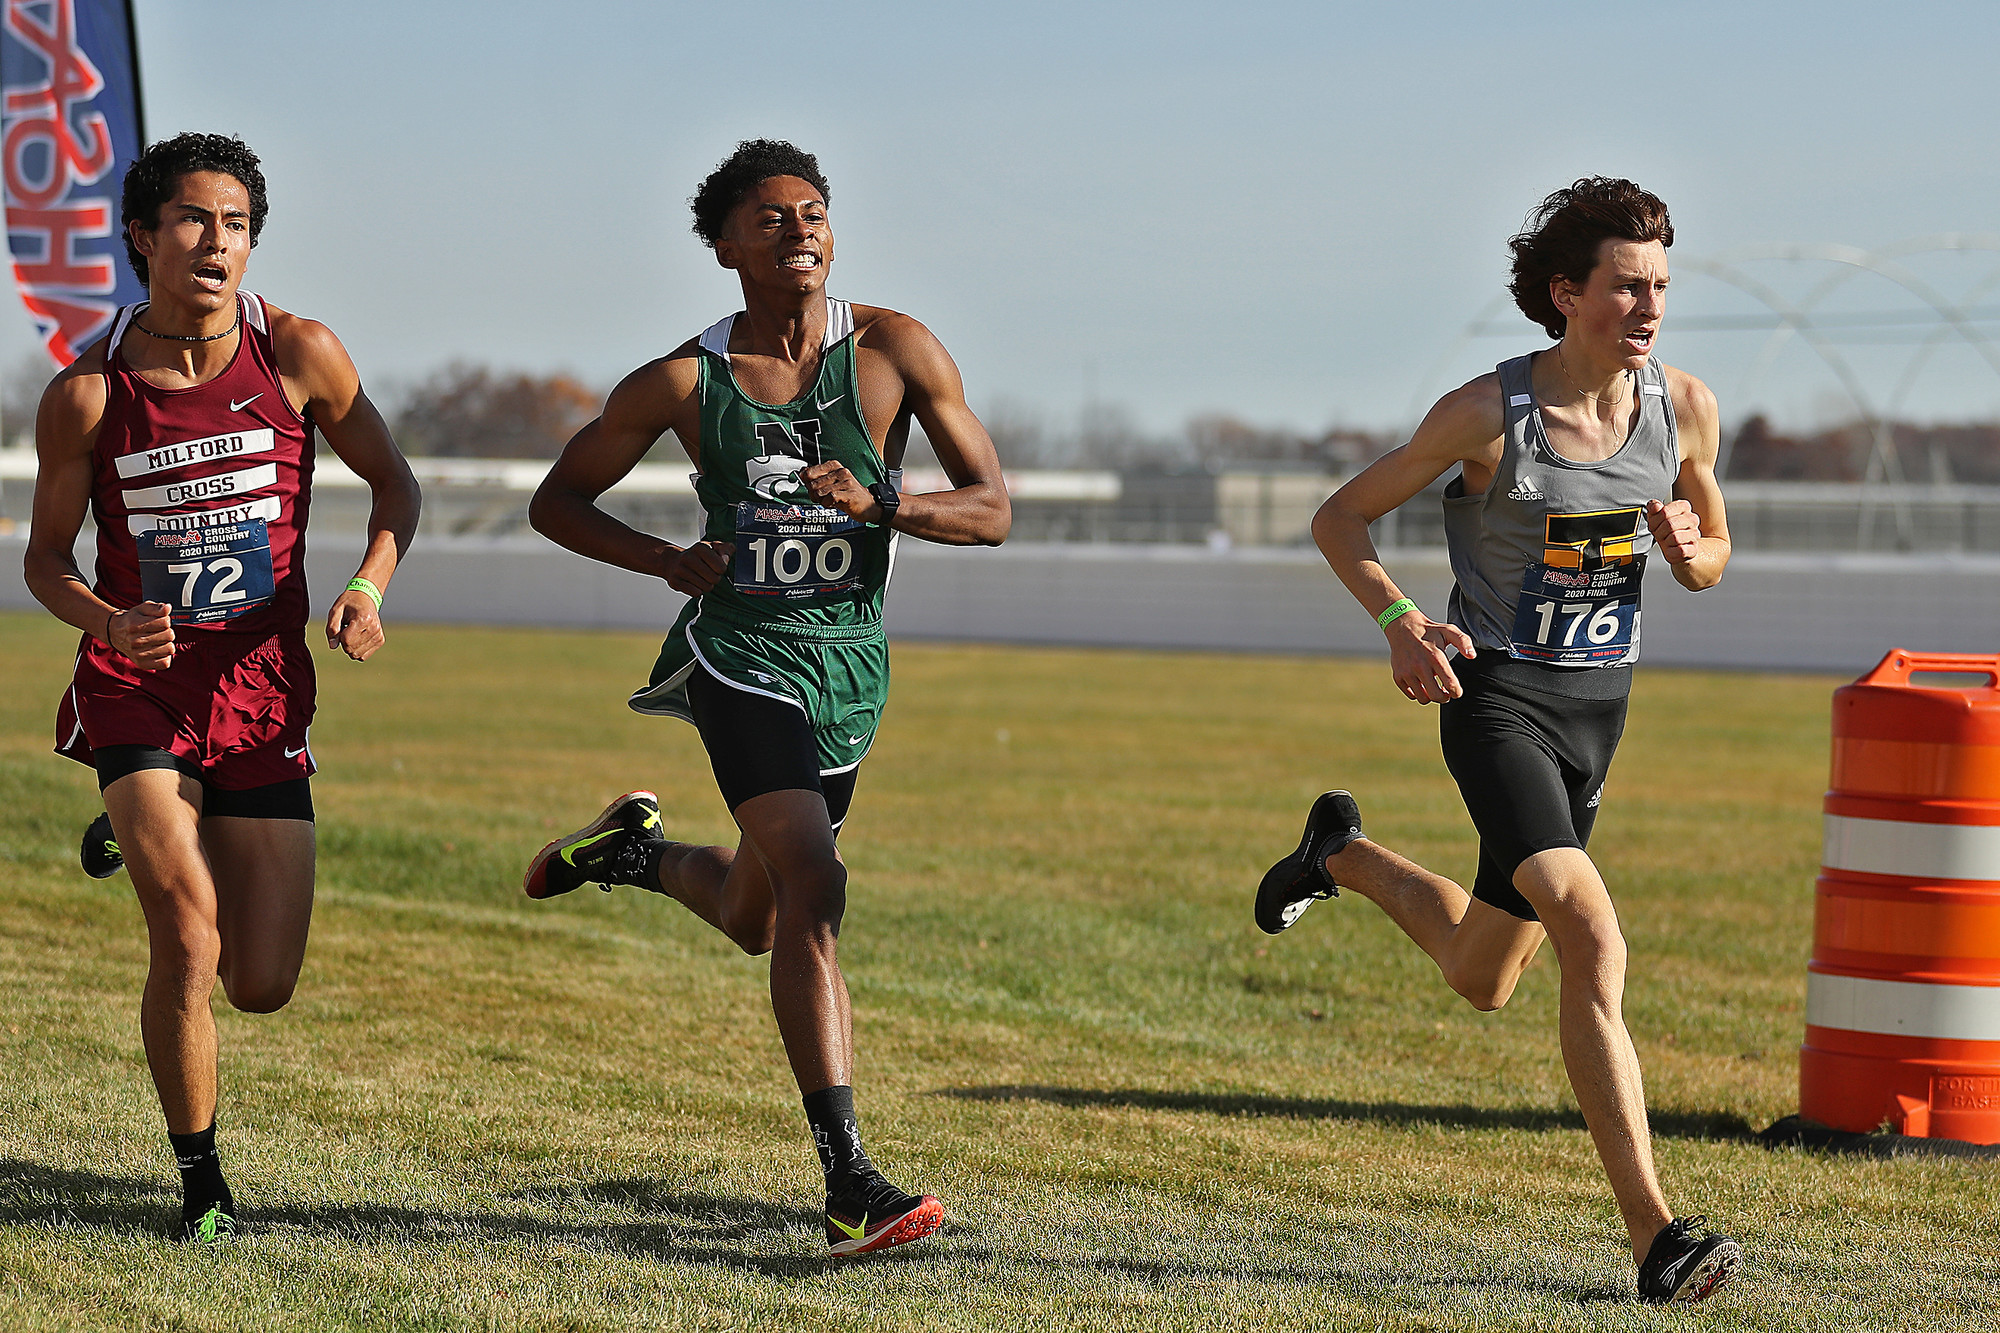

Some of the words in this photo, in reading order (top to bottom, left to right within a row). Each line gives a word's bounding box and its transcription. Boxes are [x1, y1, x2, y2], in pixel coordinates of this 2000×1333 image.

[754, 418, 822, 466] N
[146, 435, 243, 470] MILFORD
[166, 475, 235, 503] CROSS
[1508, 490, 1544, 501] adidas
[805, 508, 838, 517] CROSS
[805, 515, 849, 524] COUNTRY
[204, 525, 238, 536] CROSS
[778, 525, 800, 533] 2020
[802, 525, 828, 533] FINAL
[205, 530, 250, 544] COUNTRY
[179, 547, 202, 558] 2020
[203, 543, 230, 555] FINAL
[748, 538, 852, 584] 100
[167, 557, 247, 608] 72
[1591, 577, 1628, 588] COUNTRY
[1592, 571, 1620, 581] CROSS
[1564, 590, 1585, 598] 2020
[1586, 588, 1609, 597] FINAL
[1535, 599, 1620, 647] 176
[1938, 1077, 1974, 1092] FOR
[1978, 1078, 2000, 1092] TI
